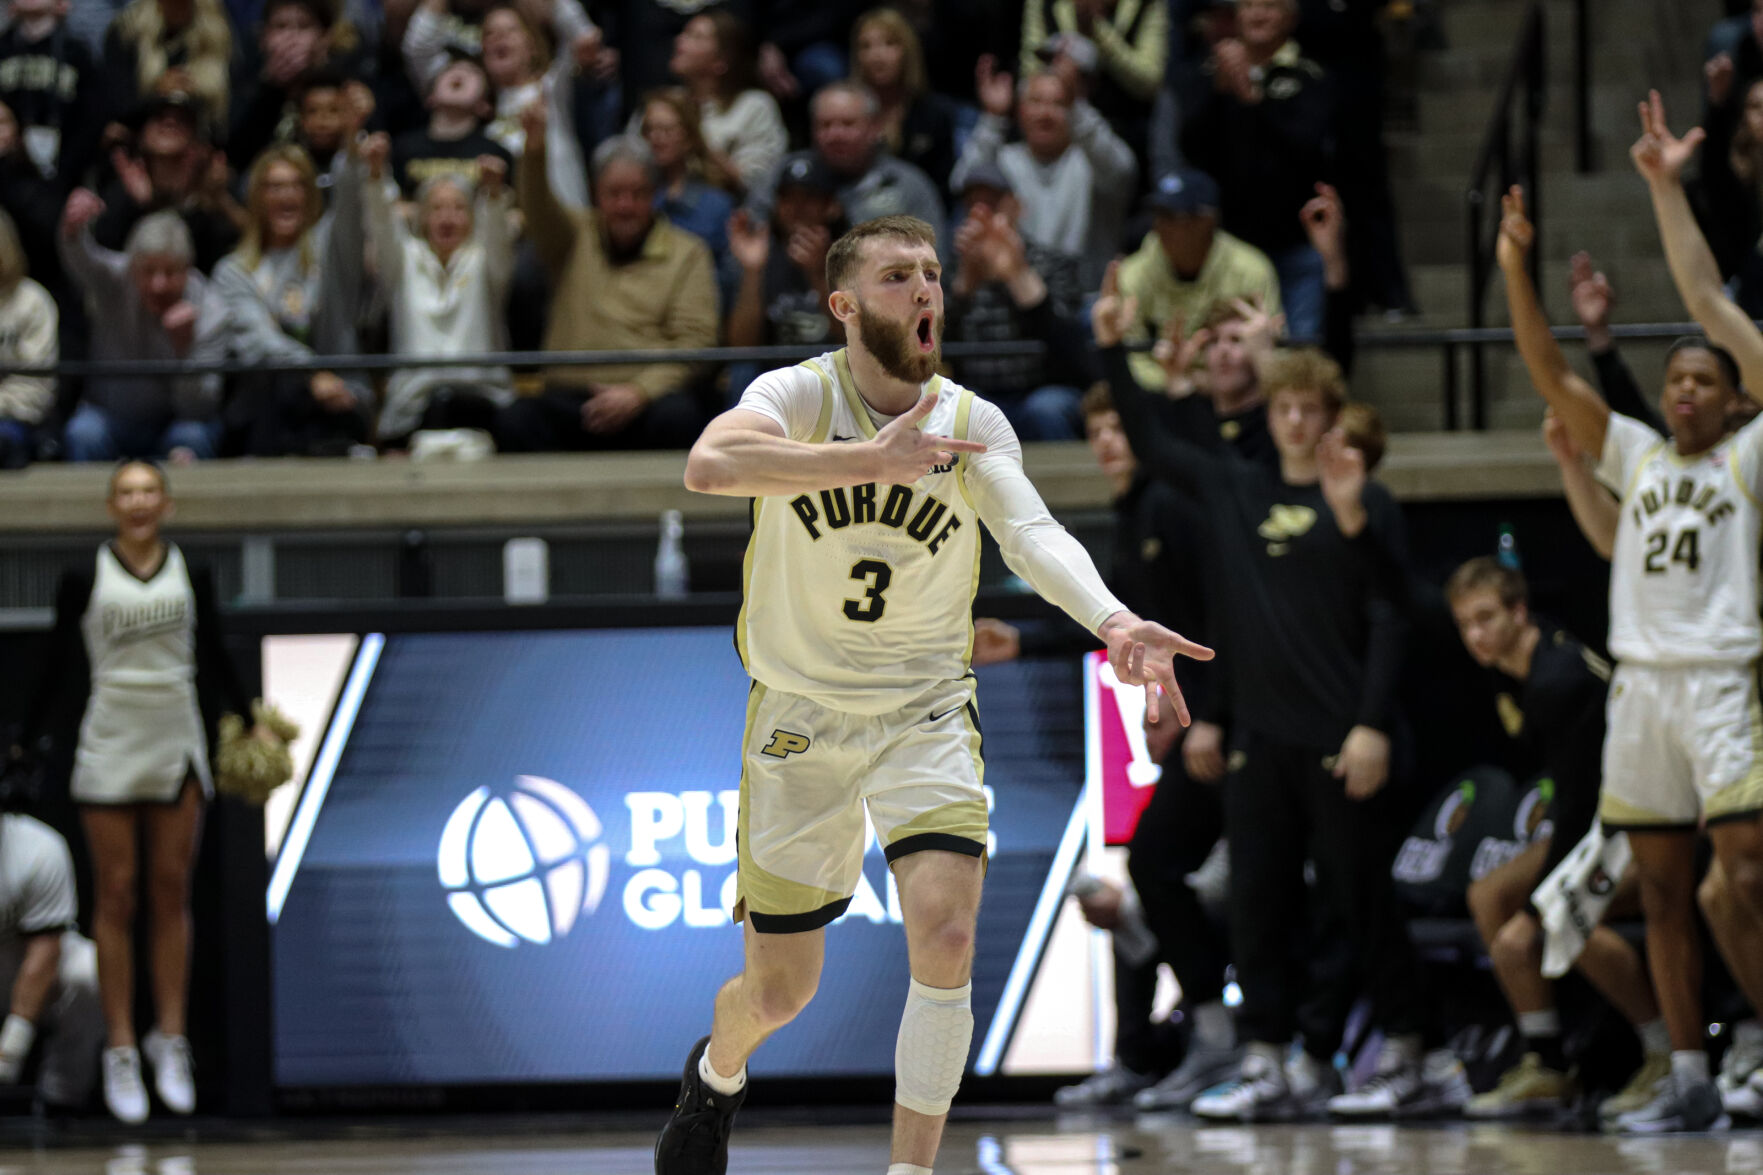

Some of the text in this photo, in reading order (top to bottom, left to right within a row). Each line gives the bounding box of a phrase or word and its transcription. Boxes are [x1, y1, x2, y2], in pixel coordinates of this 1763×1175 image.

[789, 481, 962, 556] PURDUE
[1645, 527, 1699, 573] 24
[841, 557, 894, 623] 3
[760, 728, 811, 759] P
[622, 868, 907, 931] GLA
